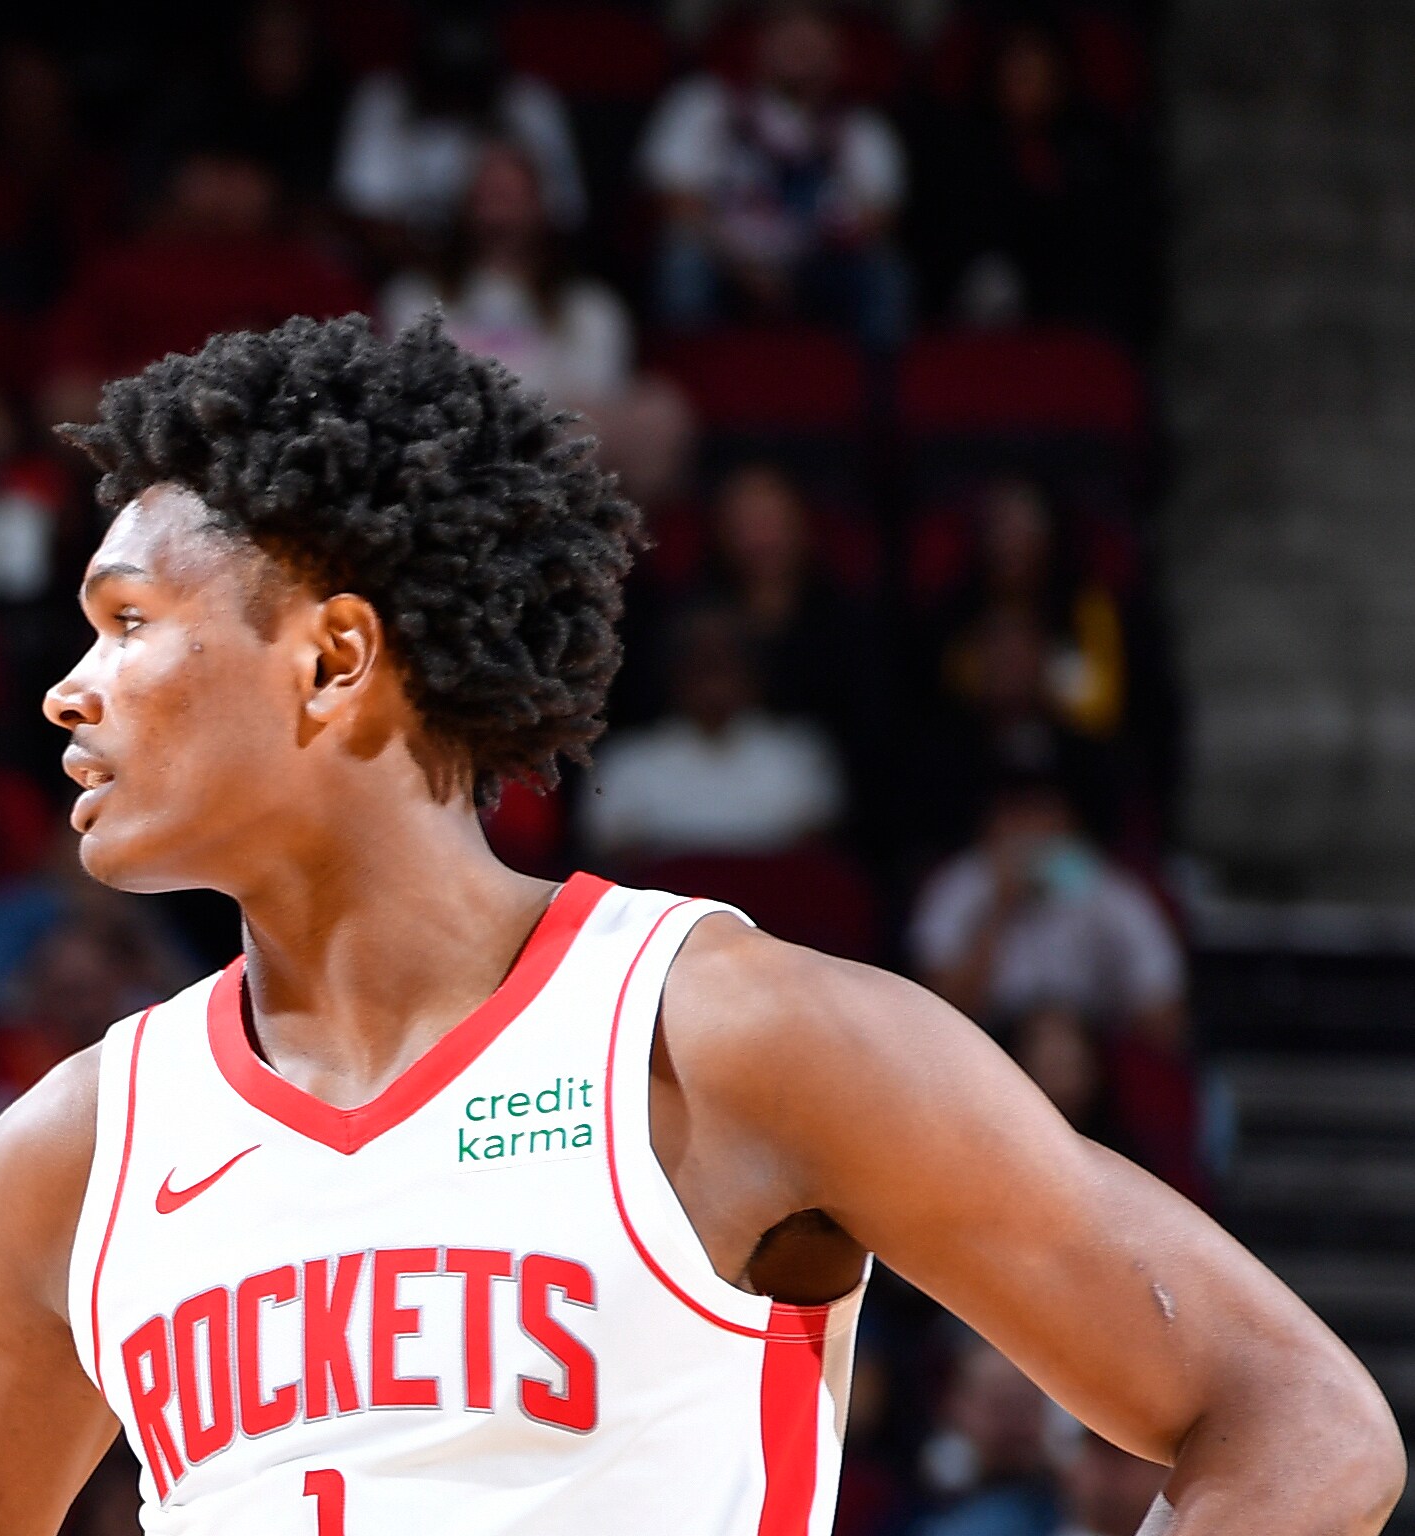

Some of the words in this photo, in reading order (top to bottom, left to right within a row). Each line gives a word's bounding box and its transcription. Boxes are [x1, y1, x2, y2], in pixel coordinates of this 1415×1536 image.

[465, 1076, 594, 1123] credit
[457, 1121, 594, 1164] karma
[119, 1244, 600, 1510] ROCKETS
